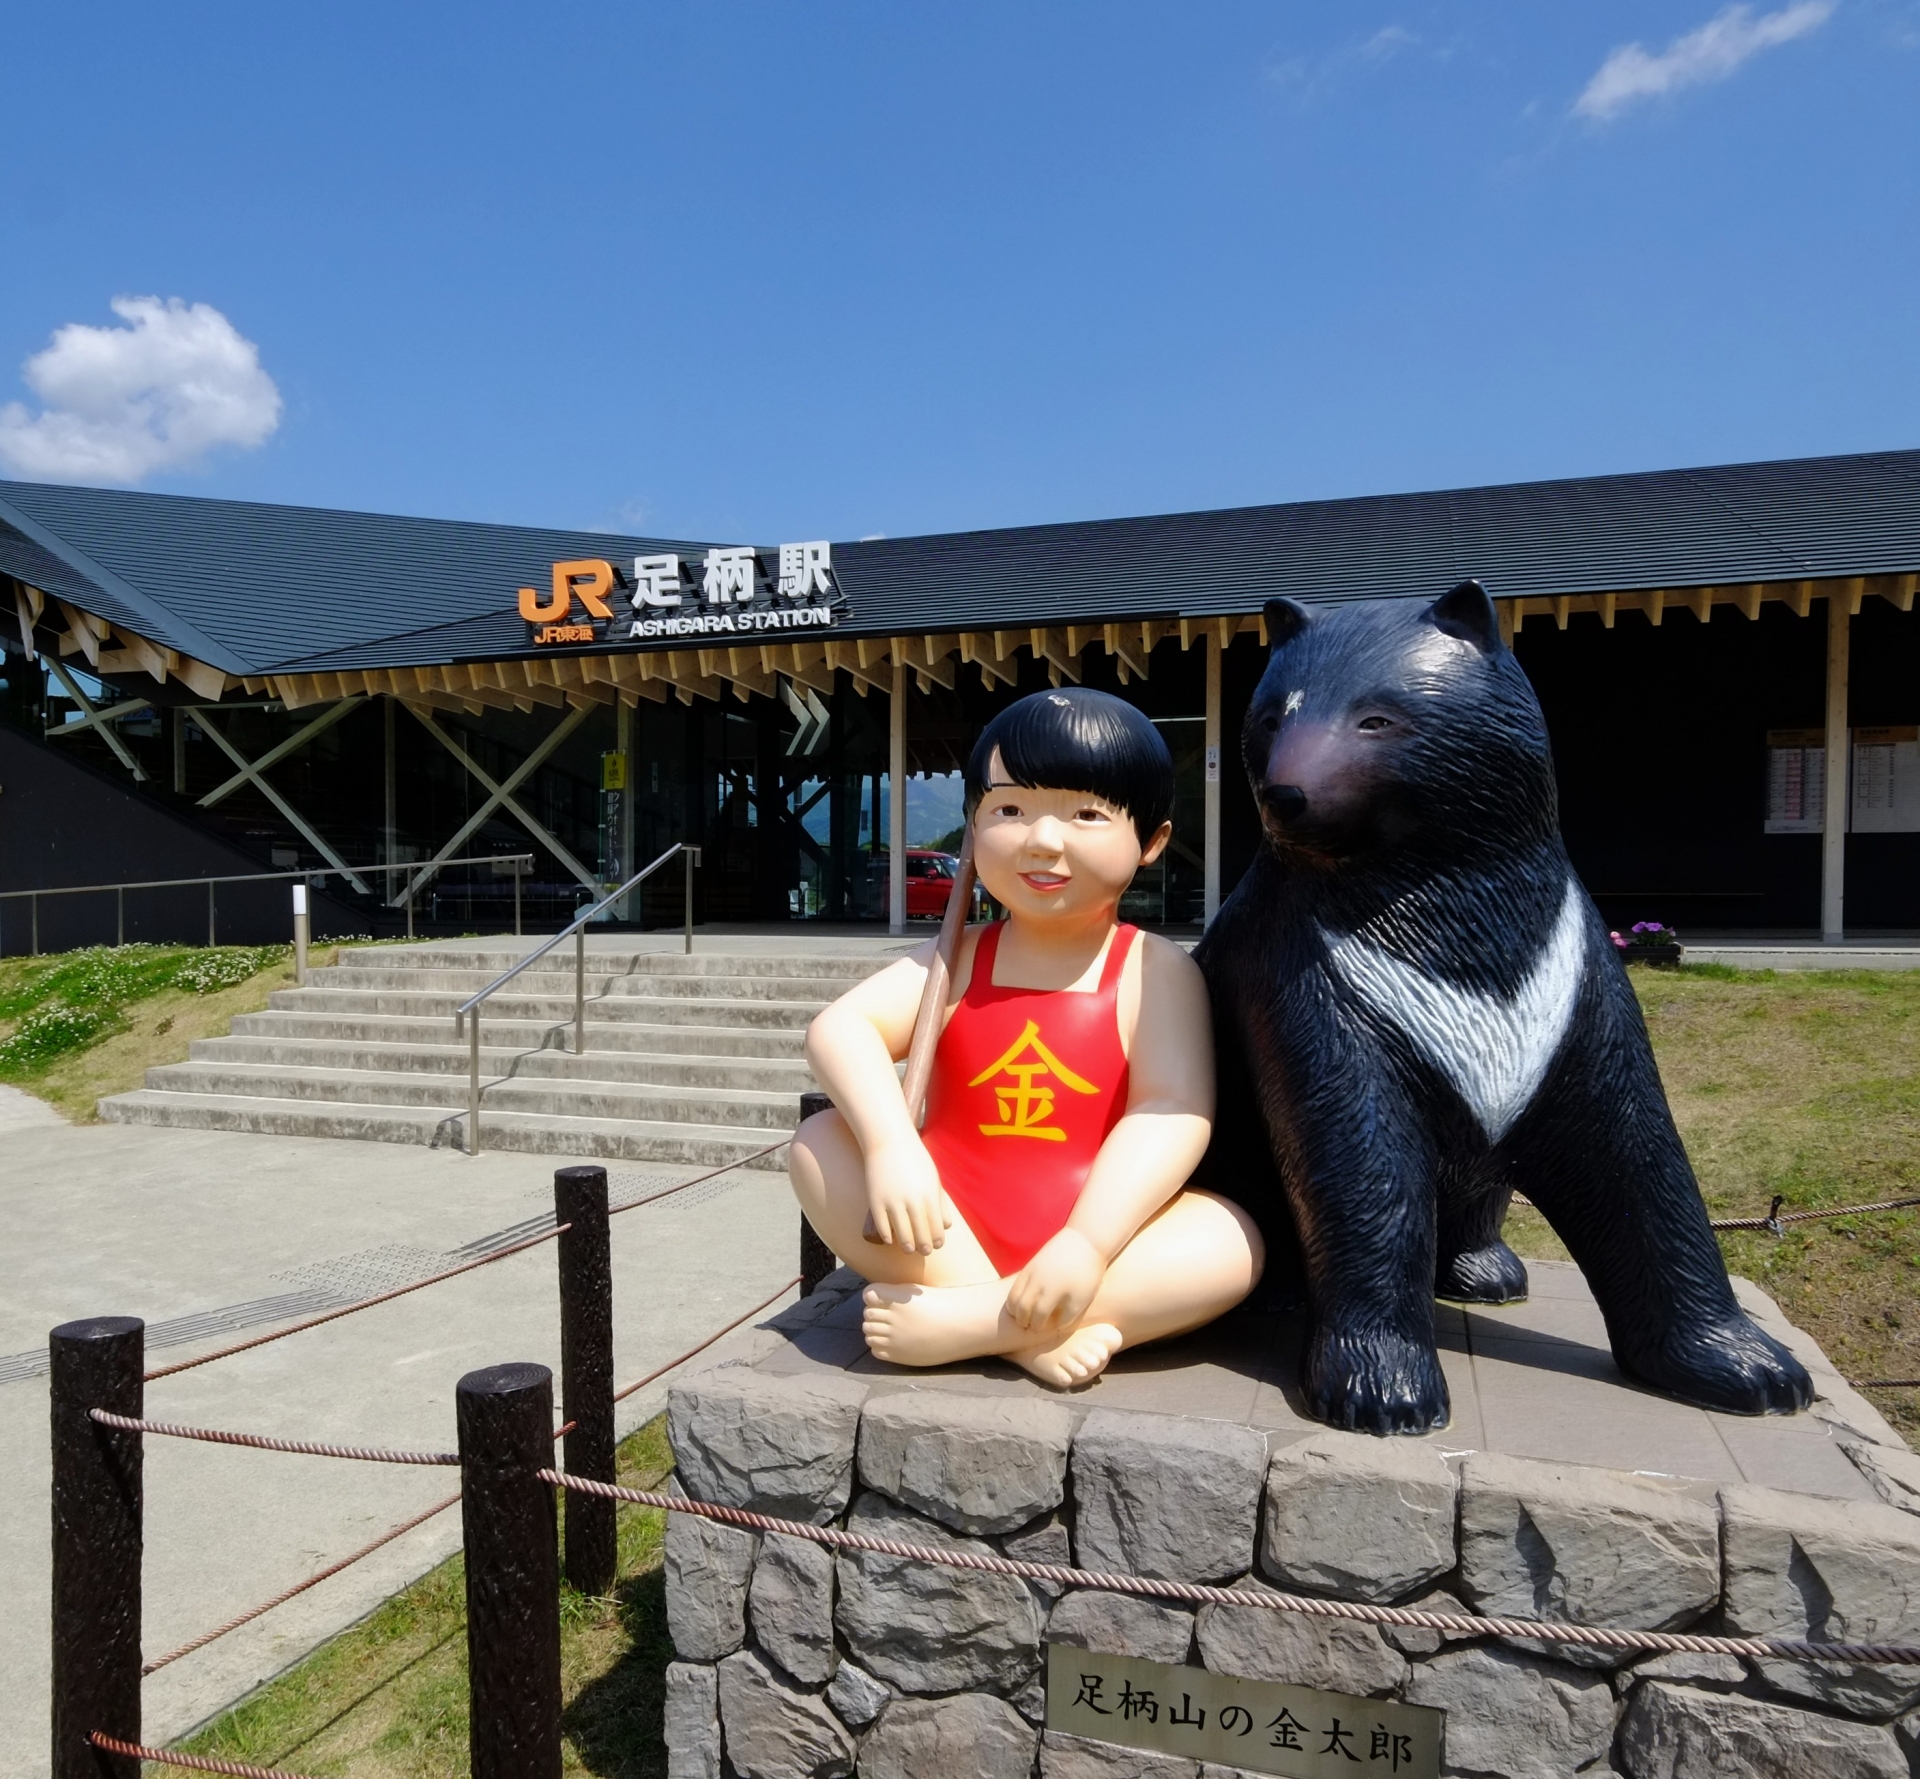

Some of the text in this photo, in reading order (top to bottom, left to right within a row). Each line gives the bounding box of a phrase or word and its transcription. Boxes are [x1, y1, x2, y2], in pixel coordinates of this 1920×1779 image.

[518, 558, 614, 623] JR
[631, 540, 831, 610] 足柄駅
[534, 624, 594, 644] JR東海
[629, 606, 831, 638] ASHIGARA STATION
[967, 1018, 1101, 1142] 金
[1071, 1672, 1414, 1773] 足柄山の金太郎
